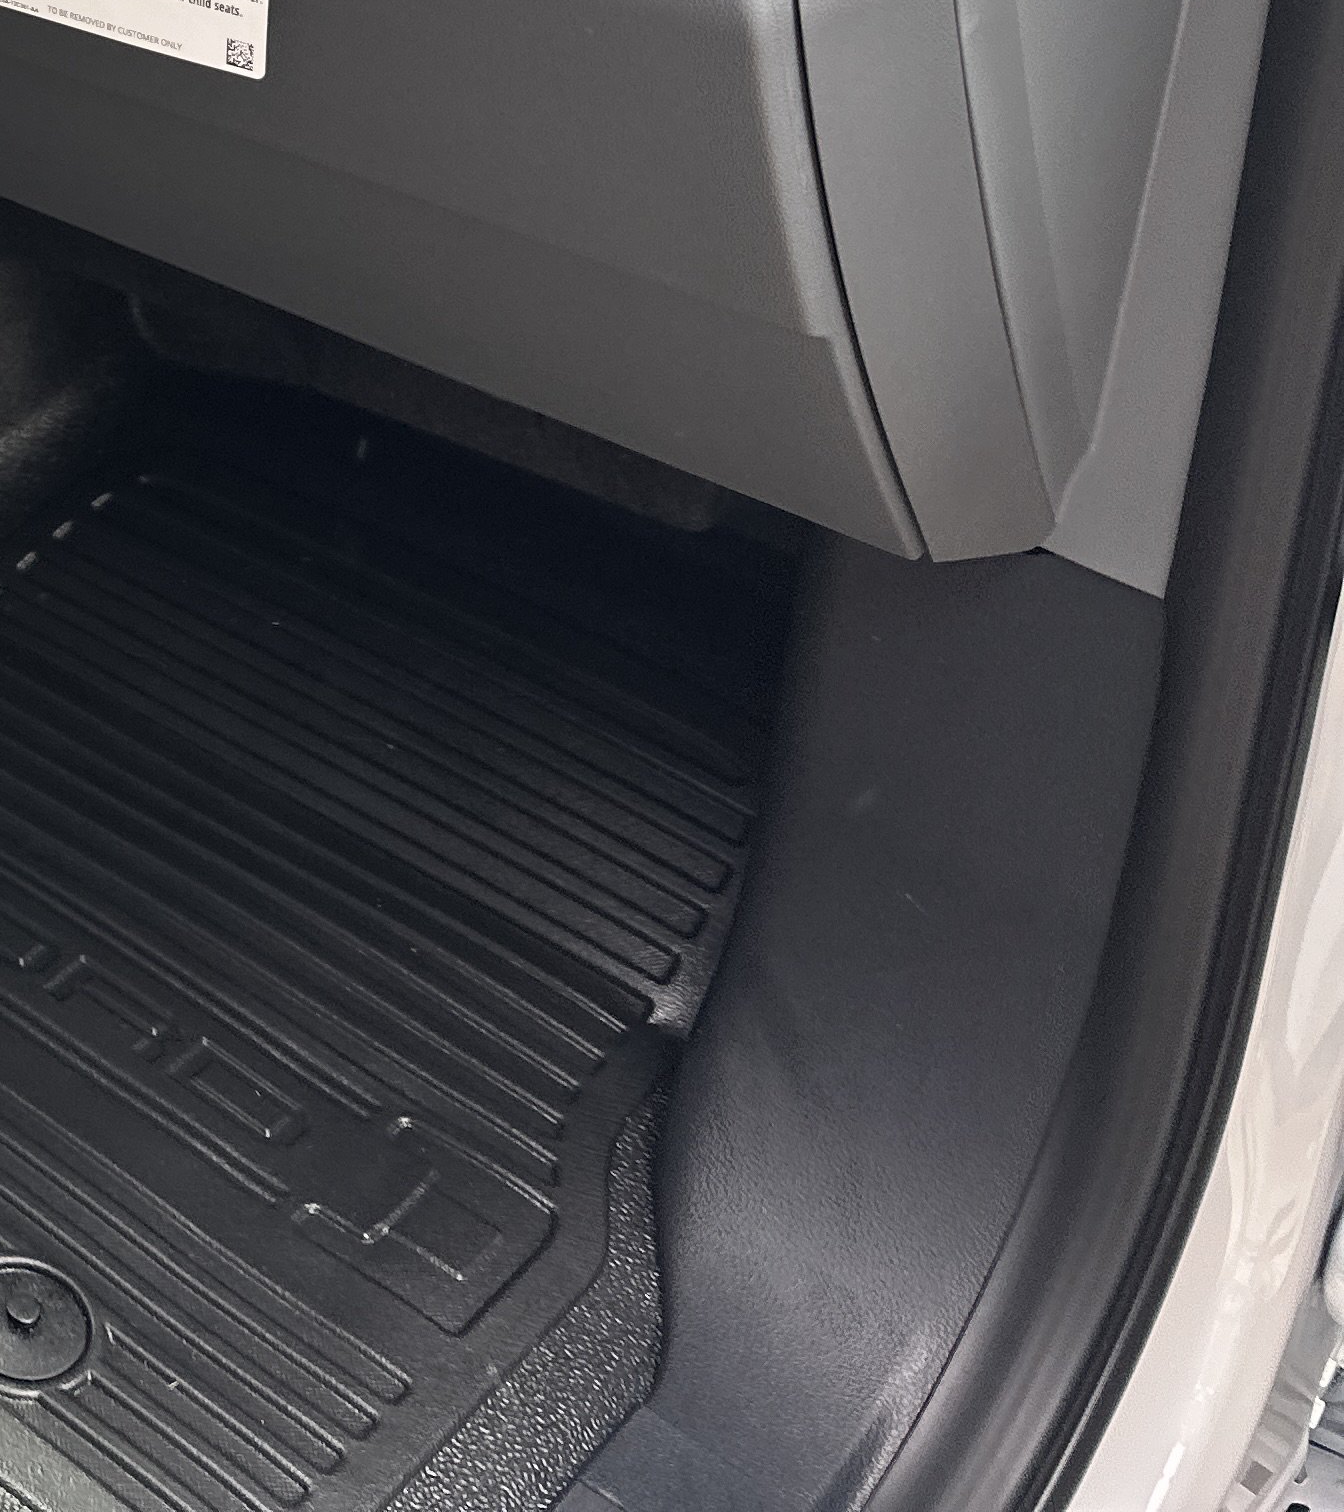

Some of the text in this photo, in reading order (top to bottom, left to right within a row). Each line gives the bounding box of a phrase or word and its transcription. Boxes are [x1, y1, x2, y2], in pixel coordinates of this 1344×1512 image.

[214, 1, 243, 18] seats.
[47, 5, 183, 51] TO BE REMOVED BY CUSTOMER ONLY
